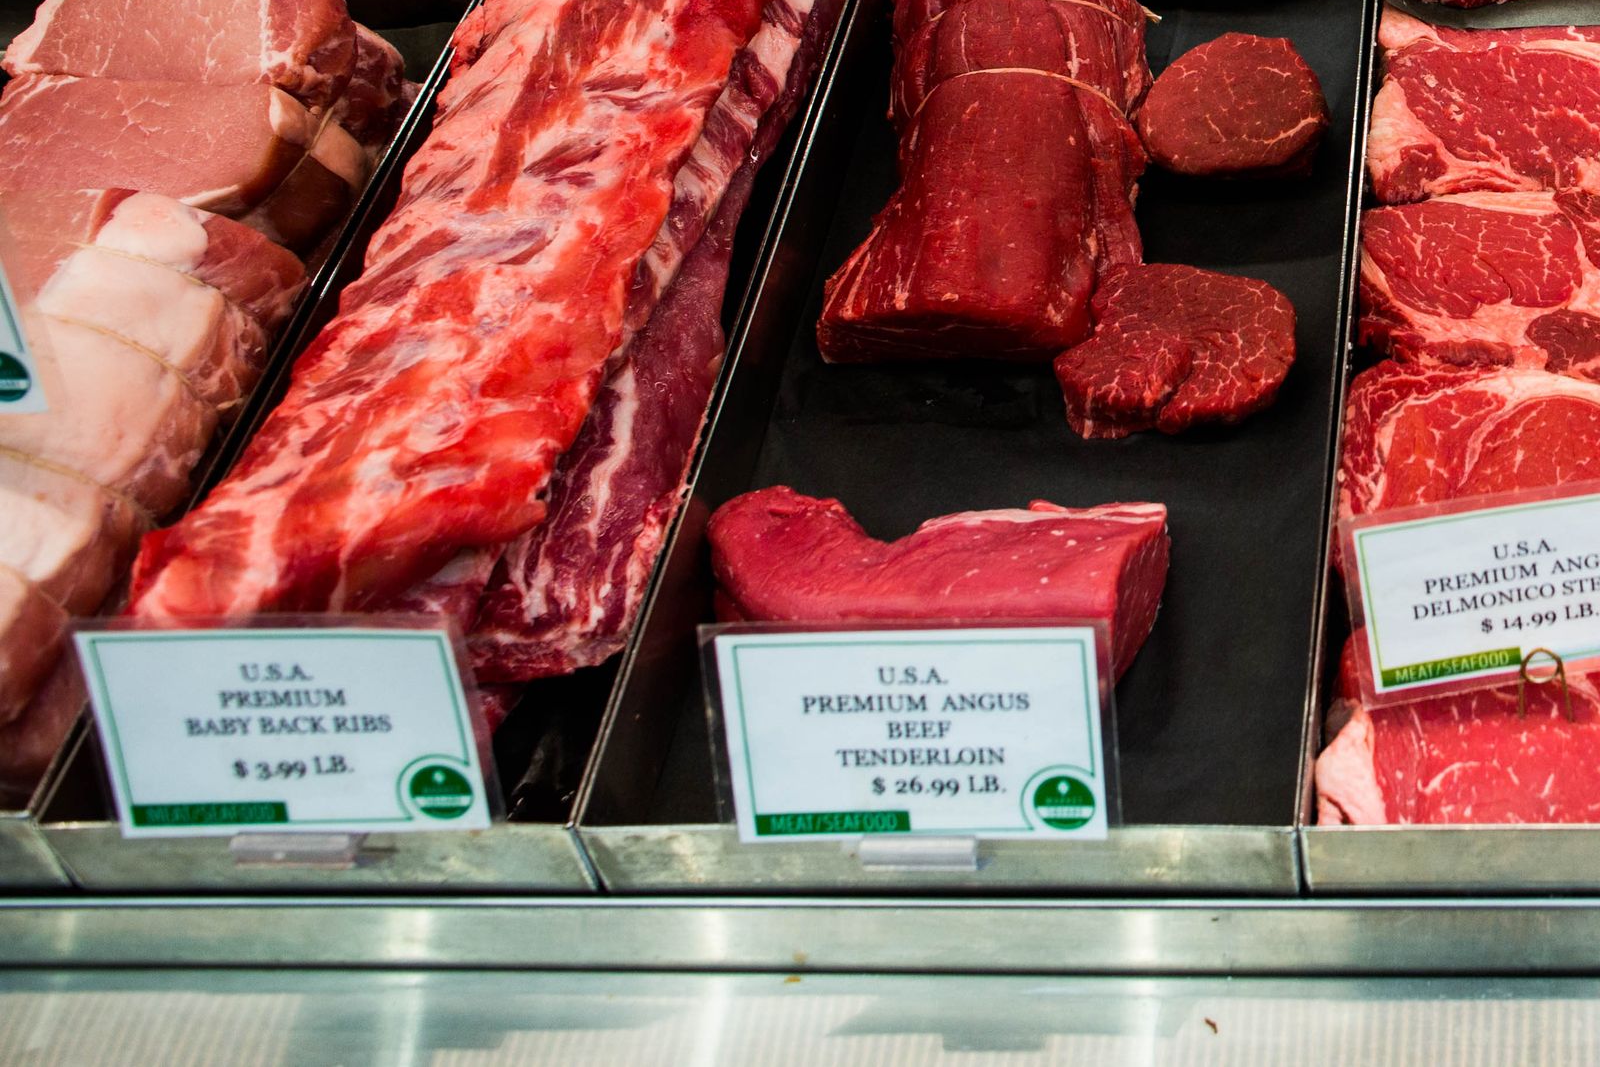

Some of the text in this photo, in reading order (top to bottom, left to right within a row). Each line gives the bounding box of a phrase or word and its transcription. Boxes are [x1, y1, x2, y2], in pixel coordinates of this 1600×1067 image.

[1493, 539, 1557, 560] U.S.A.
[1425, 563, 1538, 595] PREMIUM
[1412, 584, 1555, 621] DELMONICO
[1481, 603, 1599, 634] $ 14.99 LB.
[240, 665, 313, 681] U.S.A.
[878, 667, 949, 685] U.S.A.
[1395, 652, 1509, 683] MEAT/SEAFOOD
[219, 690, 346, 709] PREMIUM
[802, 693, 1030, 714] PREMIUM ANGUS
[185, 715, 392, 736] BABY BACK RIBS
[887, 721, 952, 739] BEEF
[836, 747, 1005, 767] TENDERLOIN
[233, 756, 355, 780] $ 3.99 LB.
[872, 776, 1006, 796] $ 26.99 LB.
[771, 814, 898, 831] MEAT/SEAFOOD
